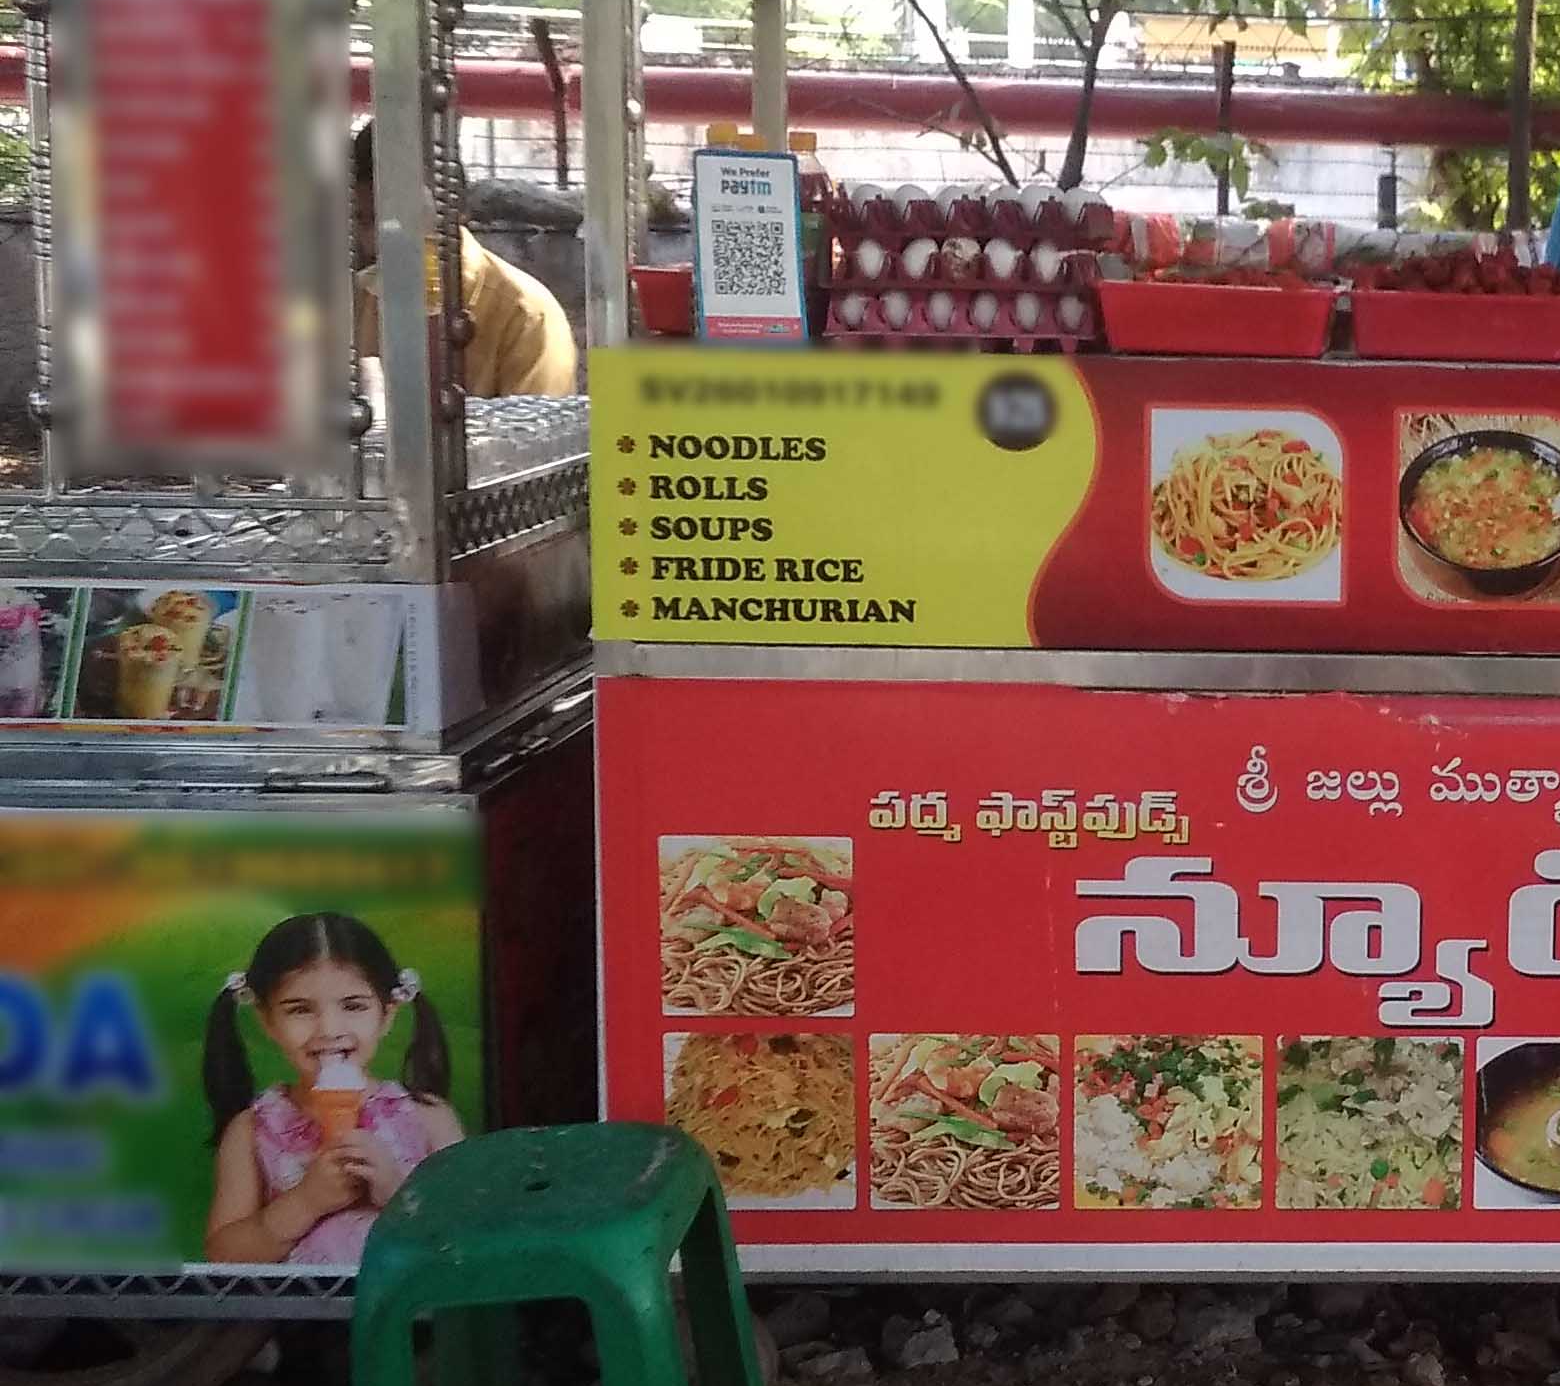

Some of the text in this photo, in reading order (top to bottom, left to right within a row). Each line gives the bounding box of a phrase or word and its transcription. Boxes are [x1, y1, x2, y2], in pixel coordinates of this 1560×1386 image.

[721, 167, 771, 177] We Prefer
[648, 435, 827, 462] NOODLES
[648, 475, 769, 502] ROLLS
[649, 516, 774, 543] SOUPS
[651, 556, 866, 584] FRIDE RICE
[652, 596, 918, 624] MANCHURIAN
[1236, 745, 1279, 814] శ్రీ
[1306, 769, 1404, 818] జల్లు
[868, 790, 963, 843] పద్మ
